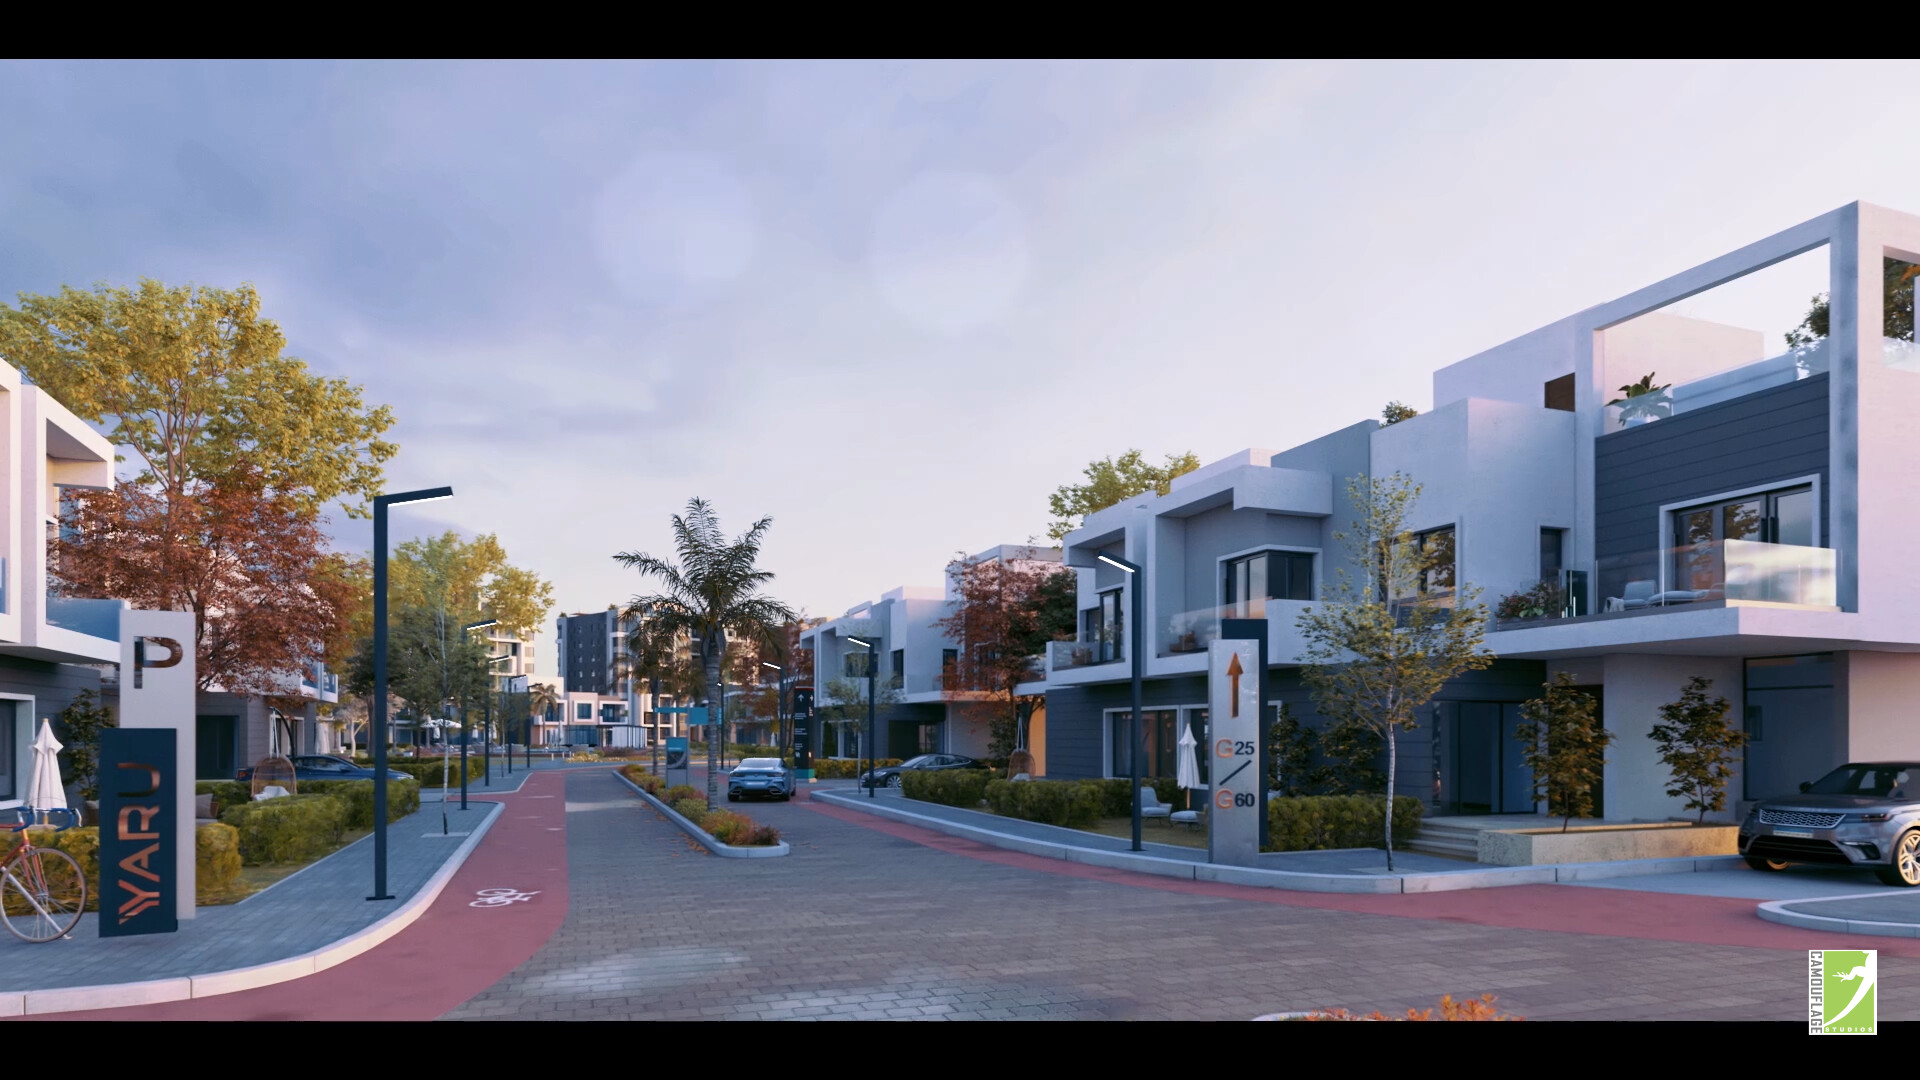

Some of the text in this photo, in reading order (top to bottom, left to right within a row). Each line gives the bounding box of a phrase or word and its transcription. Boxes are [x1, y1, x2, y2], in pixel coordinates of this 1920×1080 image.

[134, 636, 183, 689] P
[1215, 738, 1255, 759] G25
[1215, 788, 1255, 810] G60
[117, 762, 161, 925] YARU
